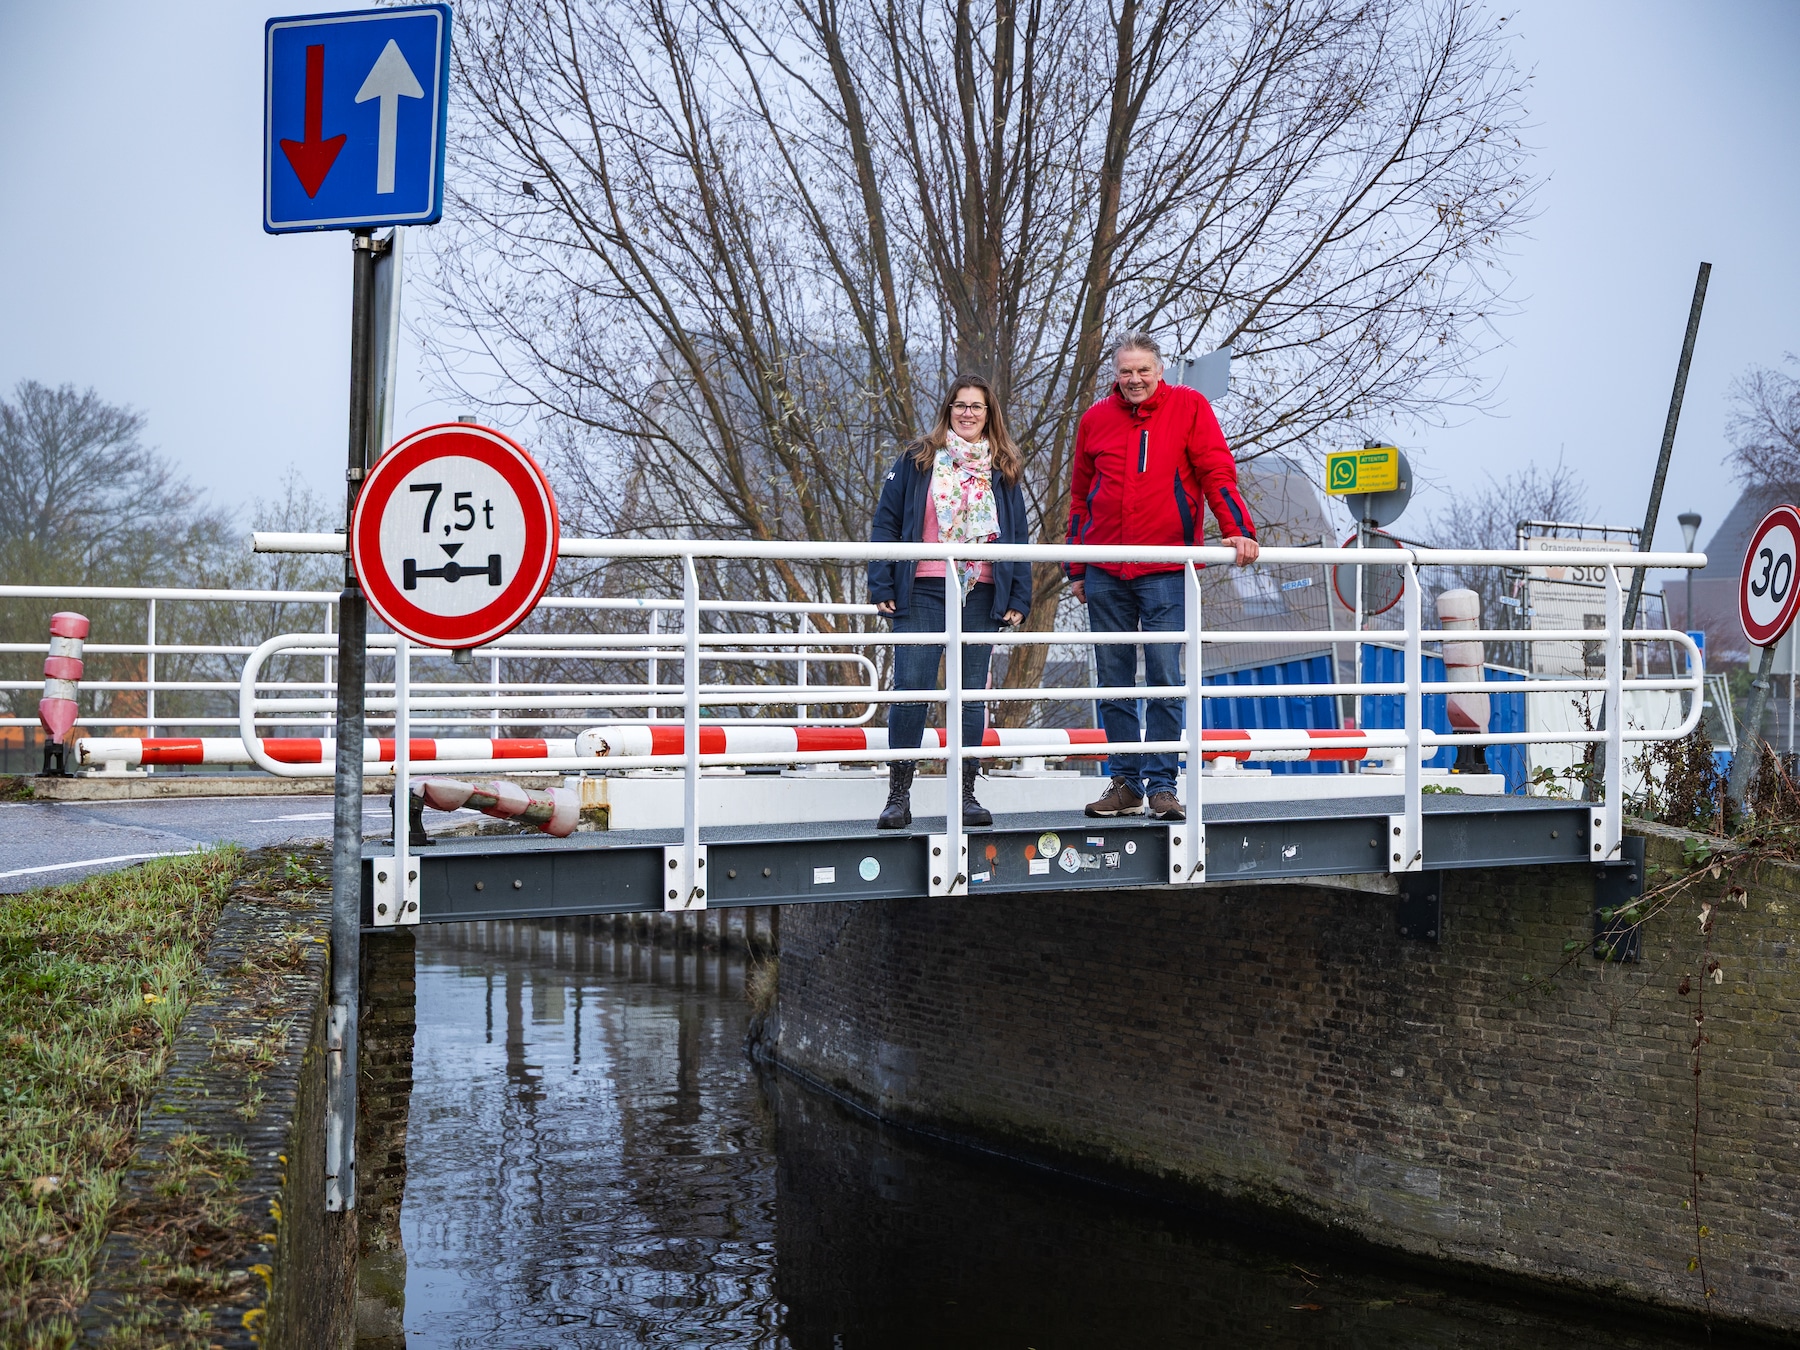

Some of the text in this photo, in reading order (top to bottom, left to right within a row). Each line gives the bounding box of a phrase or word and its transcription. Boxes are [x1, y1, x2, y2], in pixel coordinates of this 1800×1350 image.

[409, 482, 494, 537] 7,5 t
[1572, 566, 1621, 582] Sio
[1751, 548, 1792, 602] 30
